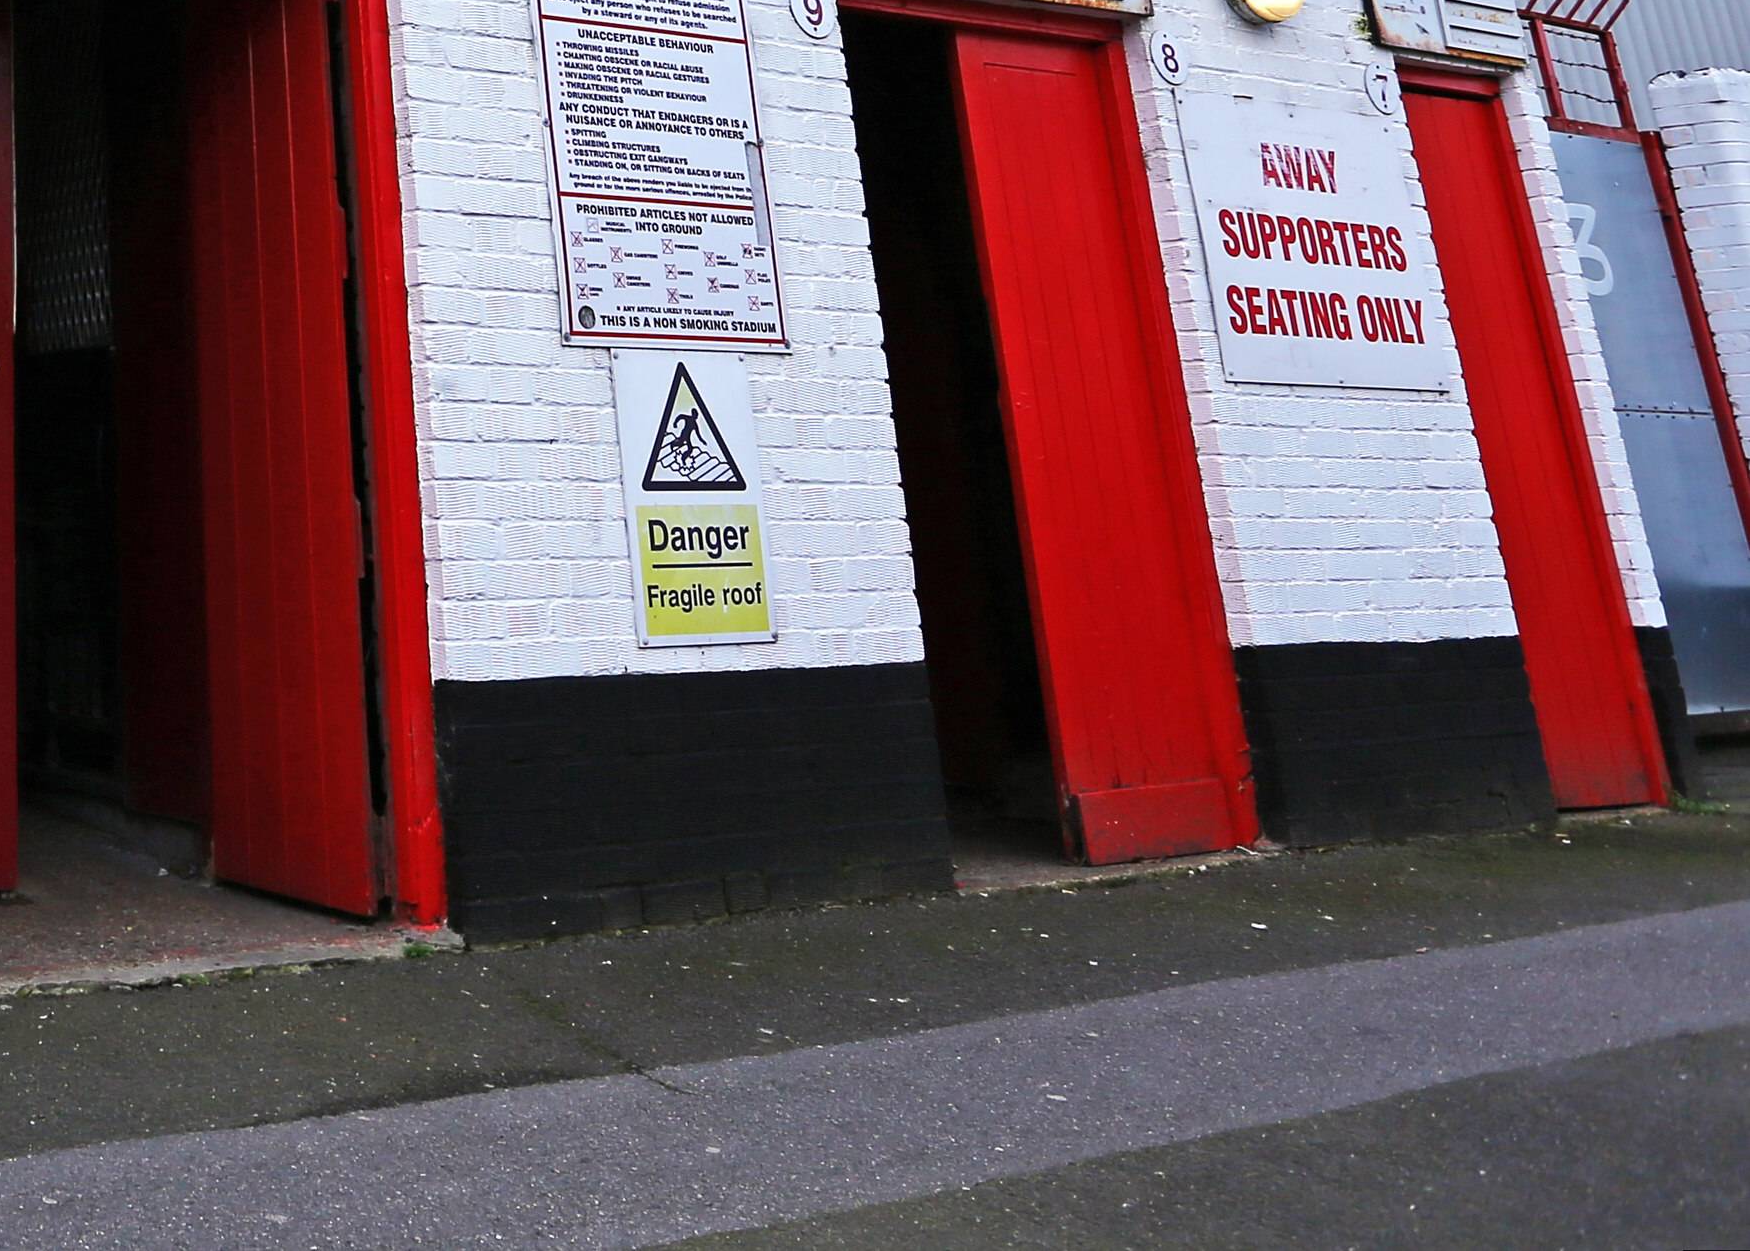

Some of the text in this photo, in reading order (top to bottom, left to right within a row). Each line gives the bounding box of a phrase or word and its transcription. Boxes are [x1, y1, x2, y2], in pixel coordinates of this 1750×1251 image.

[578, 29, 714, 54] UNACCEPTABLE BEHAVIOUR
[1162, 43, 1179, 73] 8
[603, 75, 618, 83] THE
[559, 102, 748, 129] ANY CONDUCT THAT ENDANGERS OR IS A
[566, 114, 744, 140] NUISANCE OR ANNOYANCE TO OTHERS
[1260, 141, 1338, 194] AWAY
[576, 203, 754, 226] PROHIBITED ARTICLES NOT ALLOWED
[635, 221, 659, 233] INTO
[661, 223, 703, 235] GROUND
[1218, 208, 1407, 272] SUPPORTERS
[600, 315, 777, 333] THIS IS A NON SMOKING STADIUM
[1226, 284, 1425, 345] SEATING ONLY
[648, 519, 749, 560] Danger
[647, 582, 762, 612] Fragile roof
